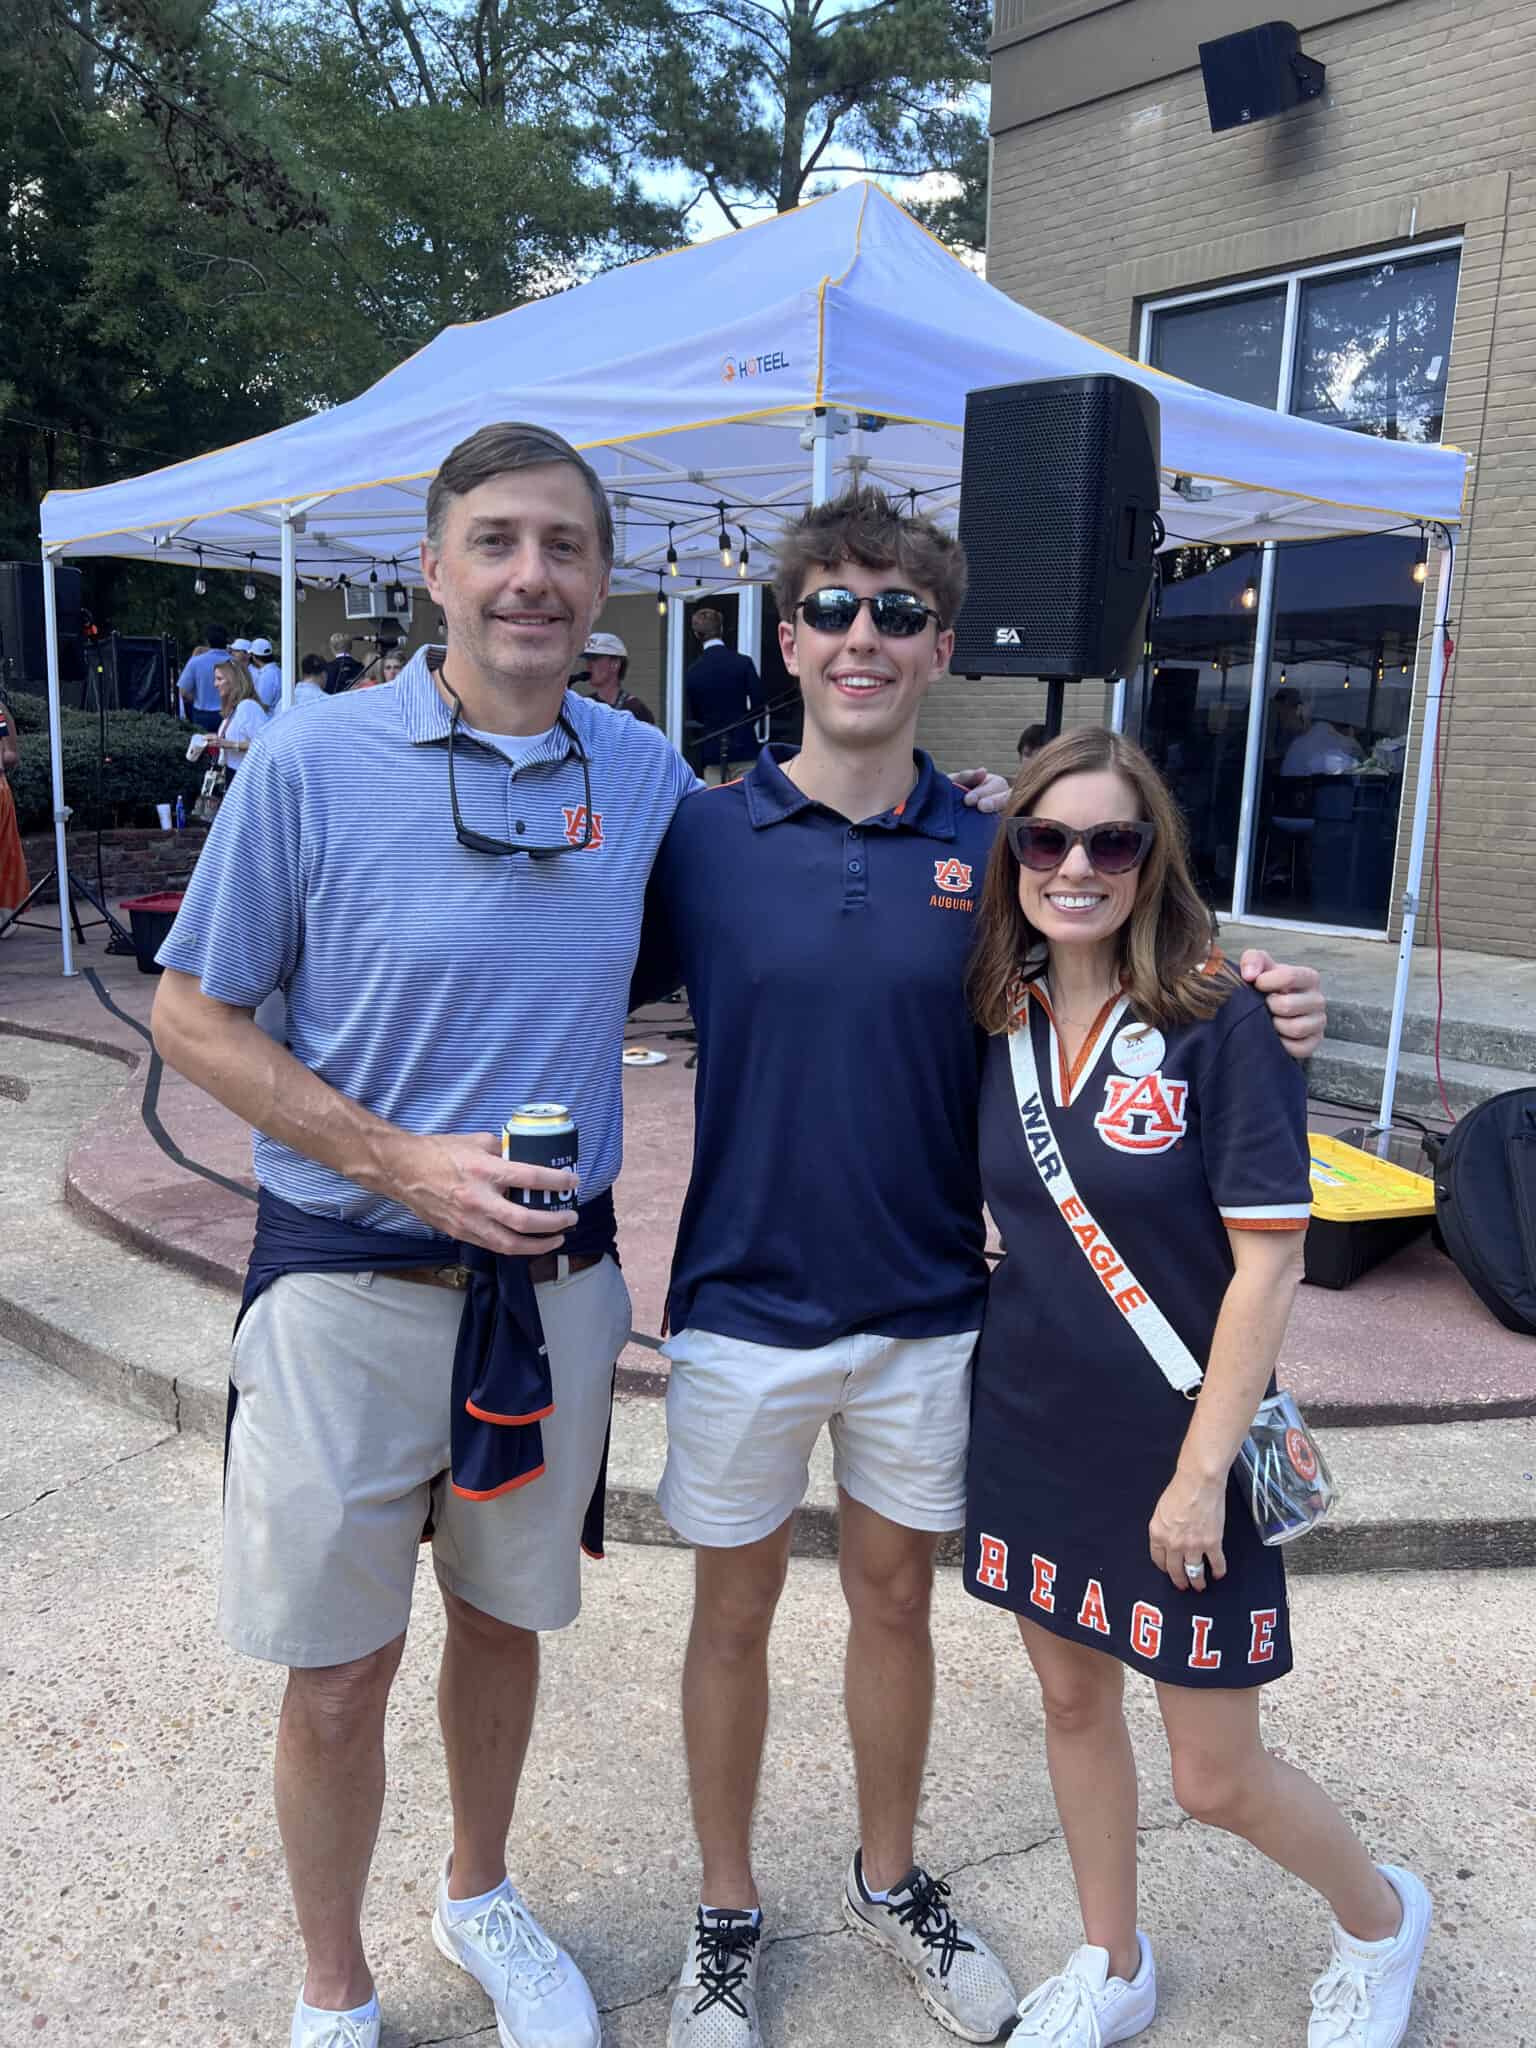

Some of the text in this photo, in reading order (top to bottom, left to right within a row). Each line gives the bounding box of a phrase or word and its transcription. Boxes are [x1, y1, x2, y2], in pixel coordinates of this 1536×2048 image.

[929, 895, 974, 913] AUBURN
[1020, 1092, 1148, 1315] WAR EAGLE
